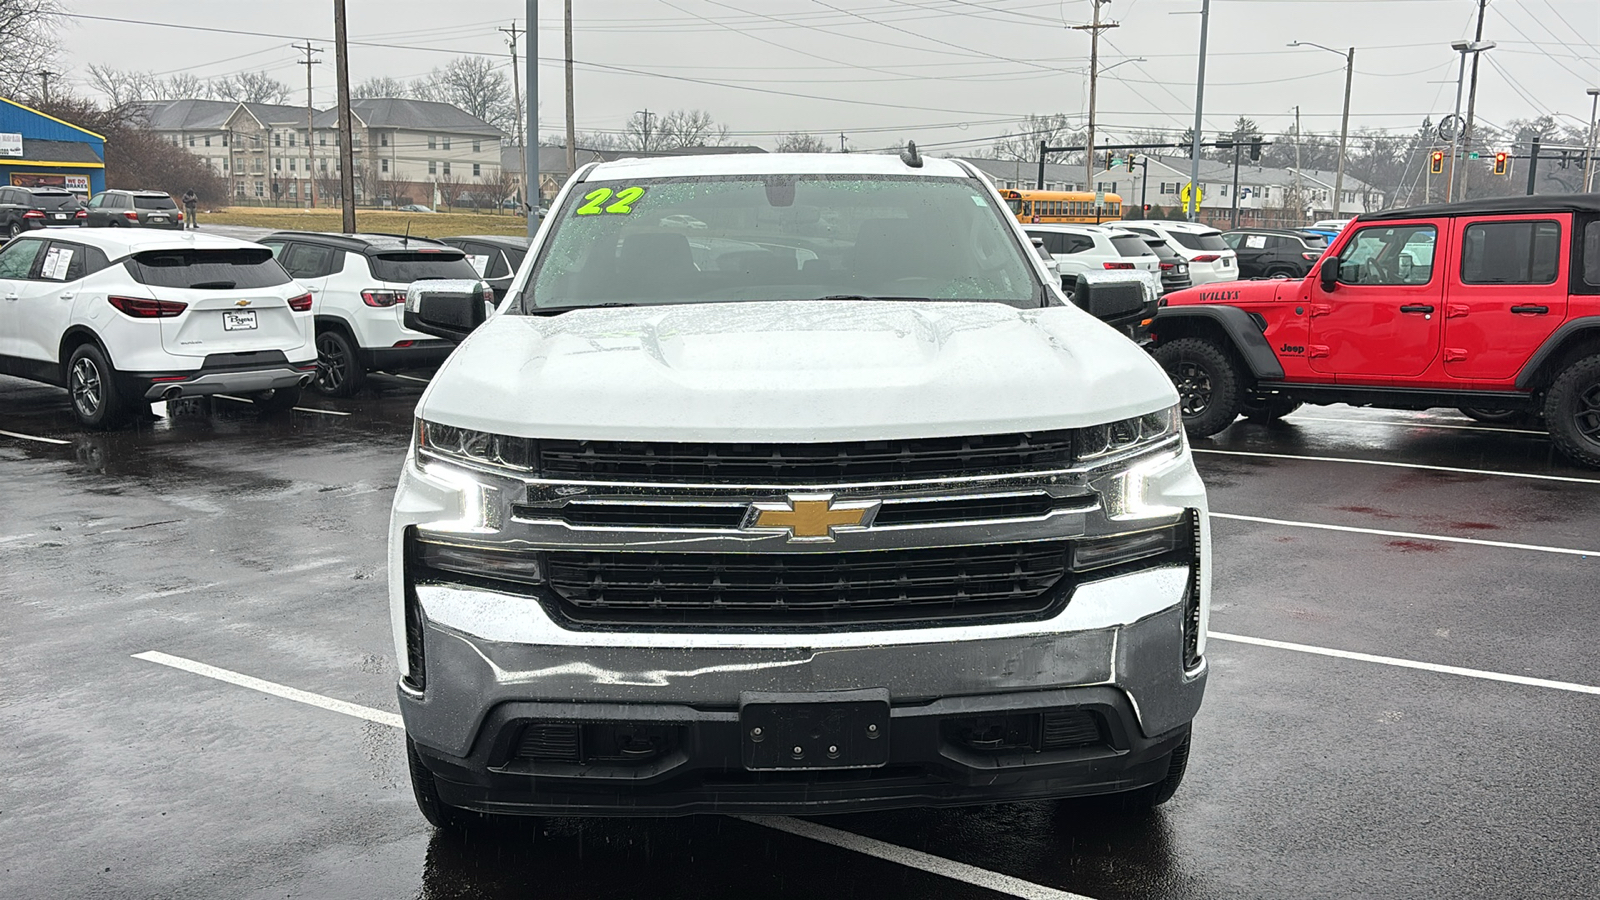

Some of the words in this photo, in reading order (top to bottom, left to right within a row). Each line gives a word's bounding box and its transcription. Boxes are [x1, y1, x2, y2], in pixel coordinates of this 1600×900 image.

[576, 187, 645, 215] 22
[1199, 290, 1241, 302] WILLYS
[1280, 343, 1305, 354] Jeep
